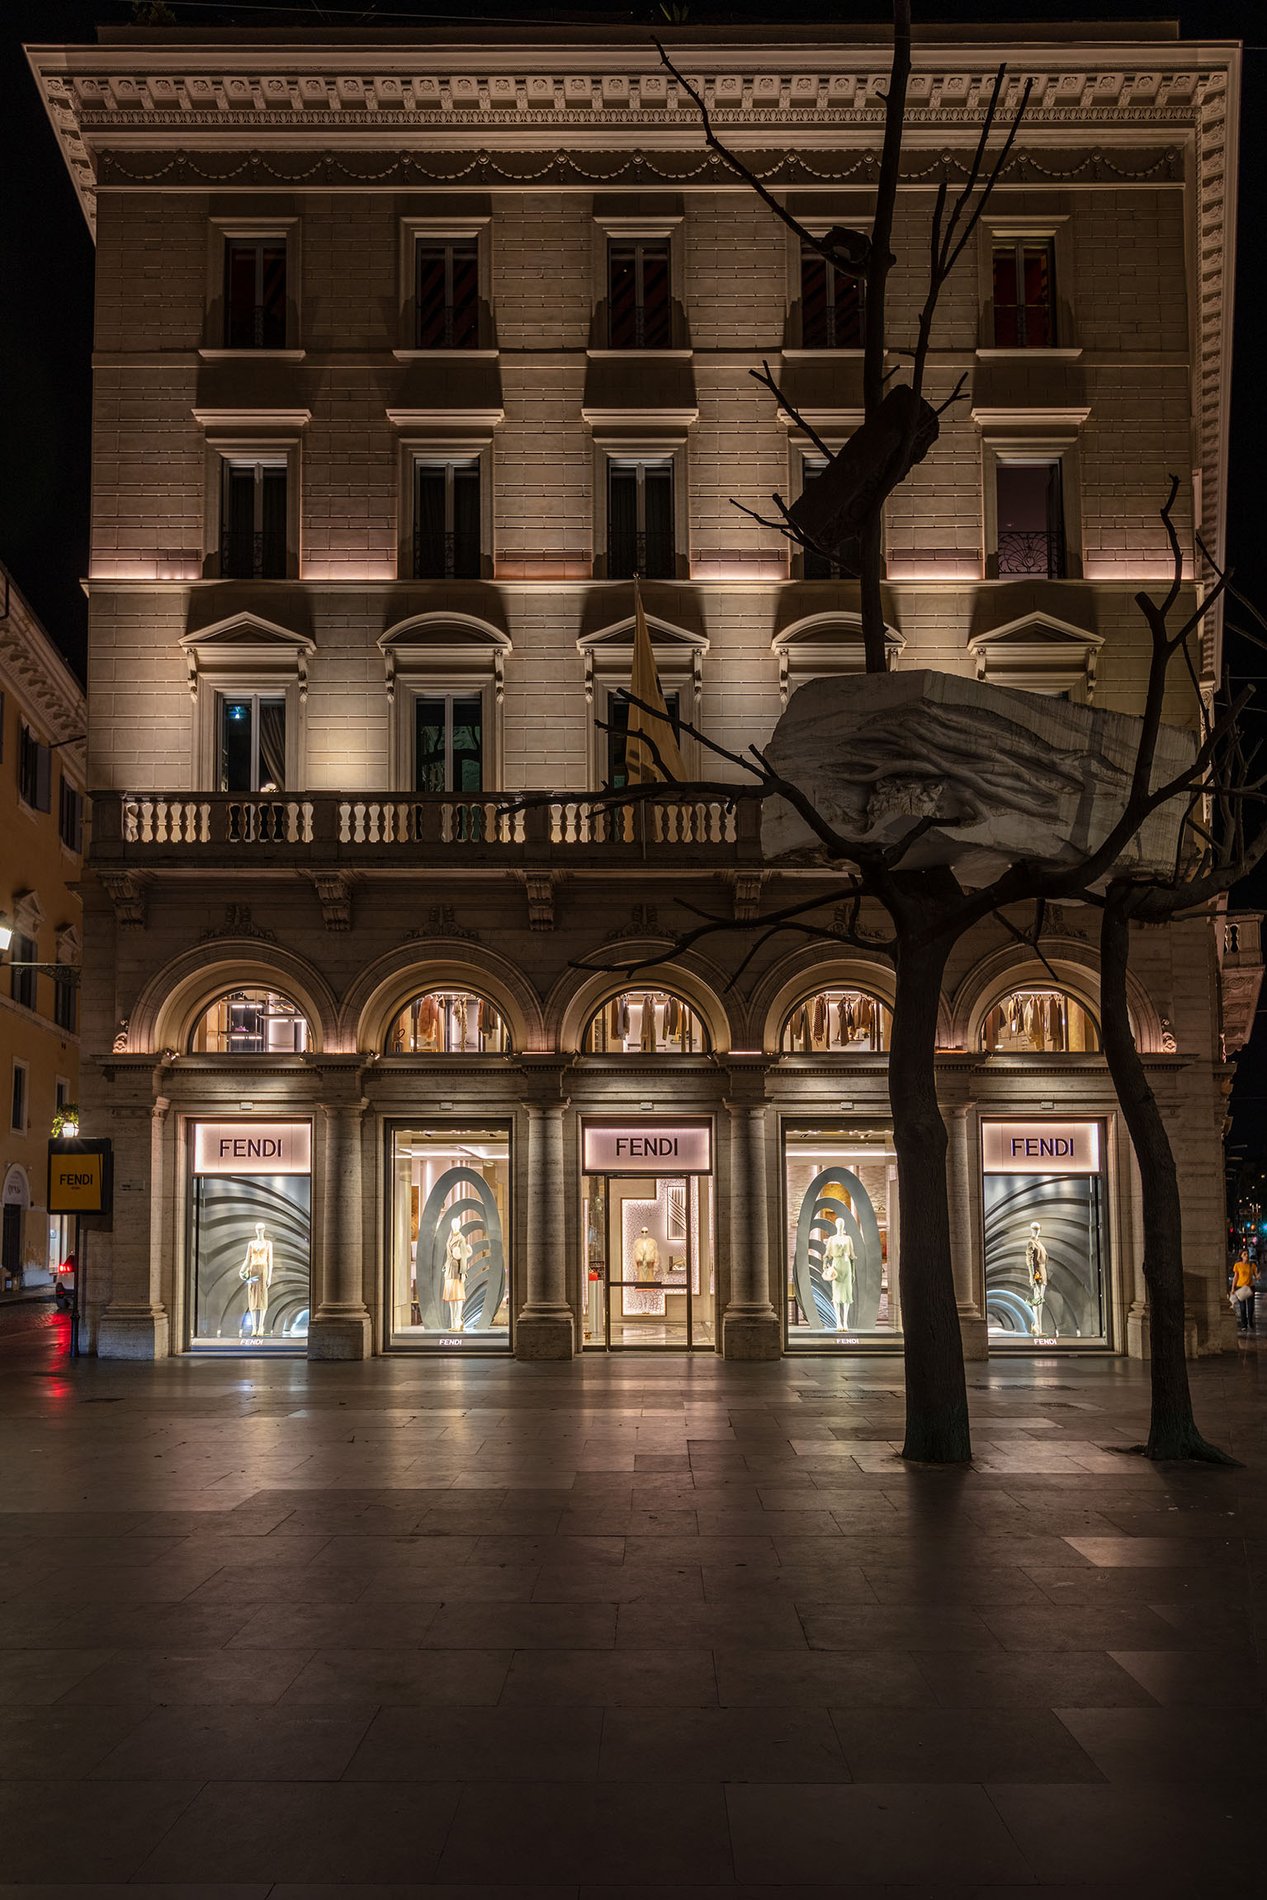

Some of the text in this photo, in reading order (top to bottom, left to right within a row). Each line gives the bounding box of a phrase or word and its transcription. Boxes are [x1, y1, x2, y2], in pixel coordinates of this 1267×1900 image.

[220, 1139, 282, 1157] FENDI
[616, 1138, 678, 1156] FENDI
[1012, 1138, 1075, 1157] FENDI
[60, 1174, 93, 1185] FENDI
